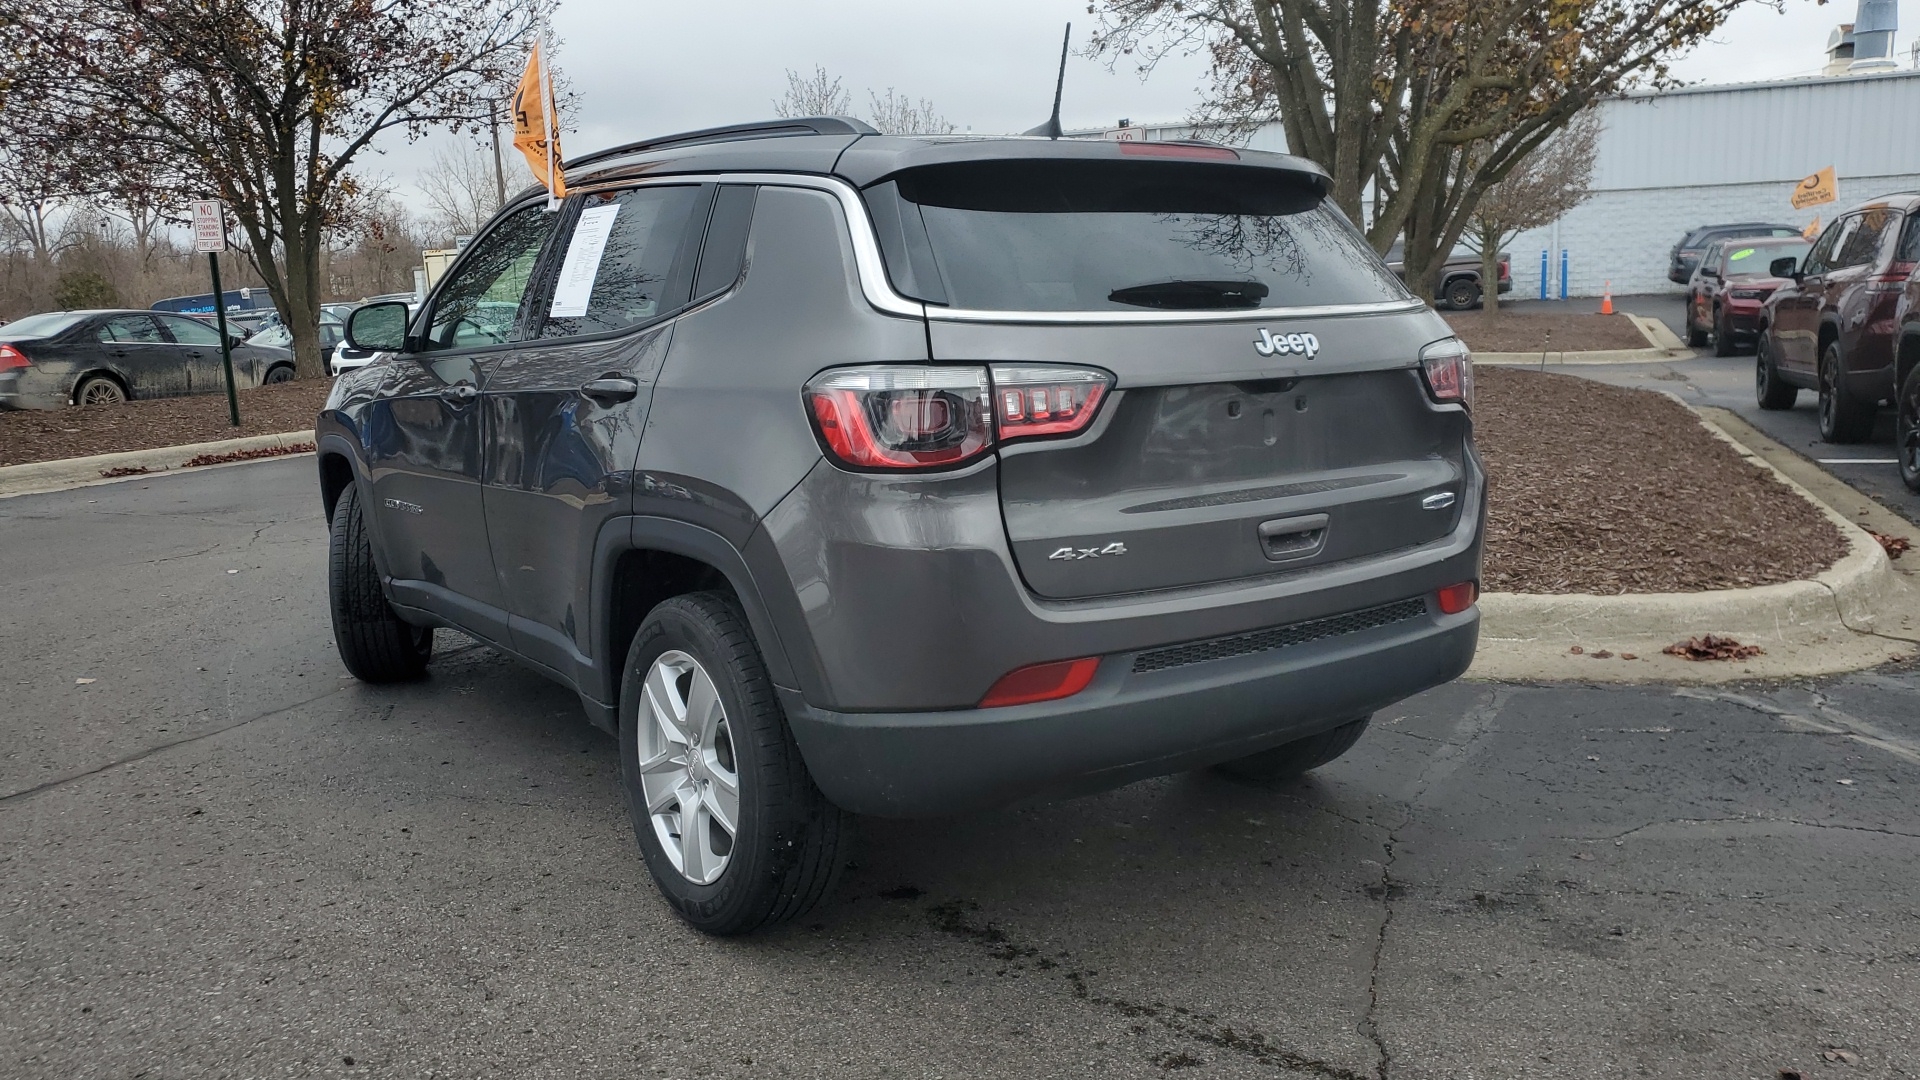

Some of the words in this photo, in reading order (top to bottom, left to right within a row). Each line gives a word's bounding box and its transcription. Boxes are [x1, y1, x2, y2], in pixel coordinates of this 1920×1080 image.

[200, 205, 212, 216] NO
[1253, 327, 1319, 360] Jeep
[1048, 542, 1128, 561] 4x4
